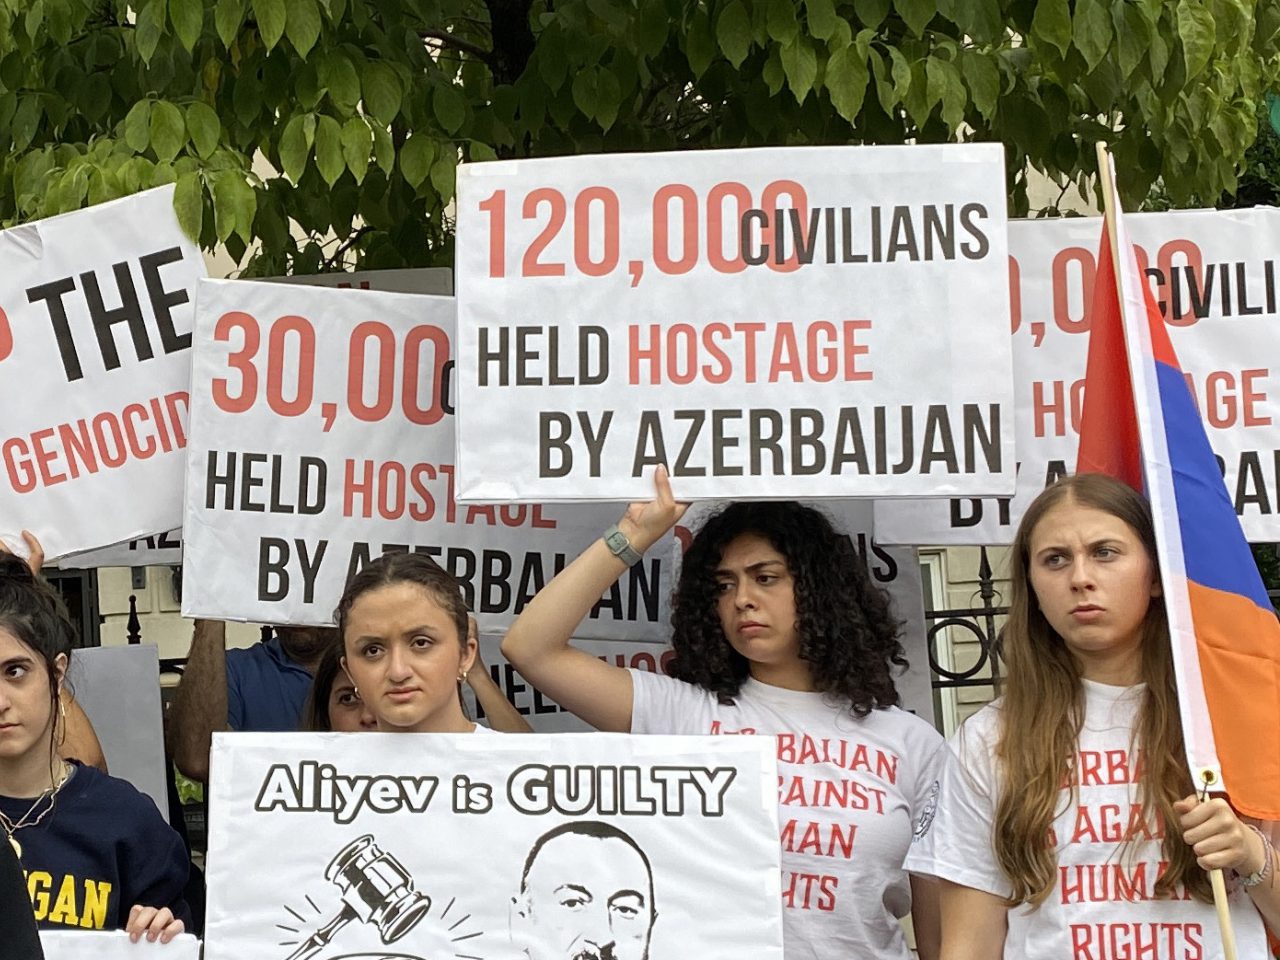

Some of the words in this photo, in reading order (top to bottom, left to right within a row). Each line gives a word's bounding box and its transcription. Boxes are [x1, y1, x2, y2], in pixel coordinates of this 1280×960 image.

[478, 180, 808, 288] 120,000
[741, 202, 990, 266] CIVILIANS
[25, 246, 192, 382] THE
[477, 326, 610, 386] HELD
[628, 320, 874, 385] HOSTAGE
[2, 391, 190, 494] GENOCID
[539, 410, 614, 478] BY
[631, 404, 1002, 478] AZERBAIJAN
[206, 451, 327, 516] HELD
[258, 537, 328, 603] BY
[255, 762, 437, 823] Aliyev
[454, 775, 492, 814] is
[507, 765, 737, 816] GUILTY
[778, 775, 887, 815] AINST
[23, 870, 112, 929] GAN
